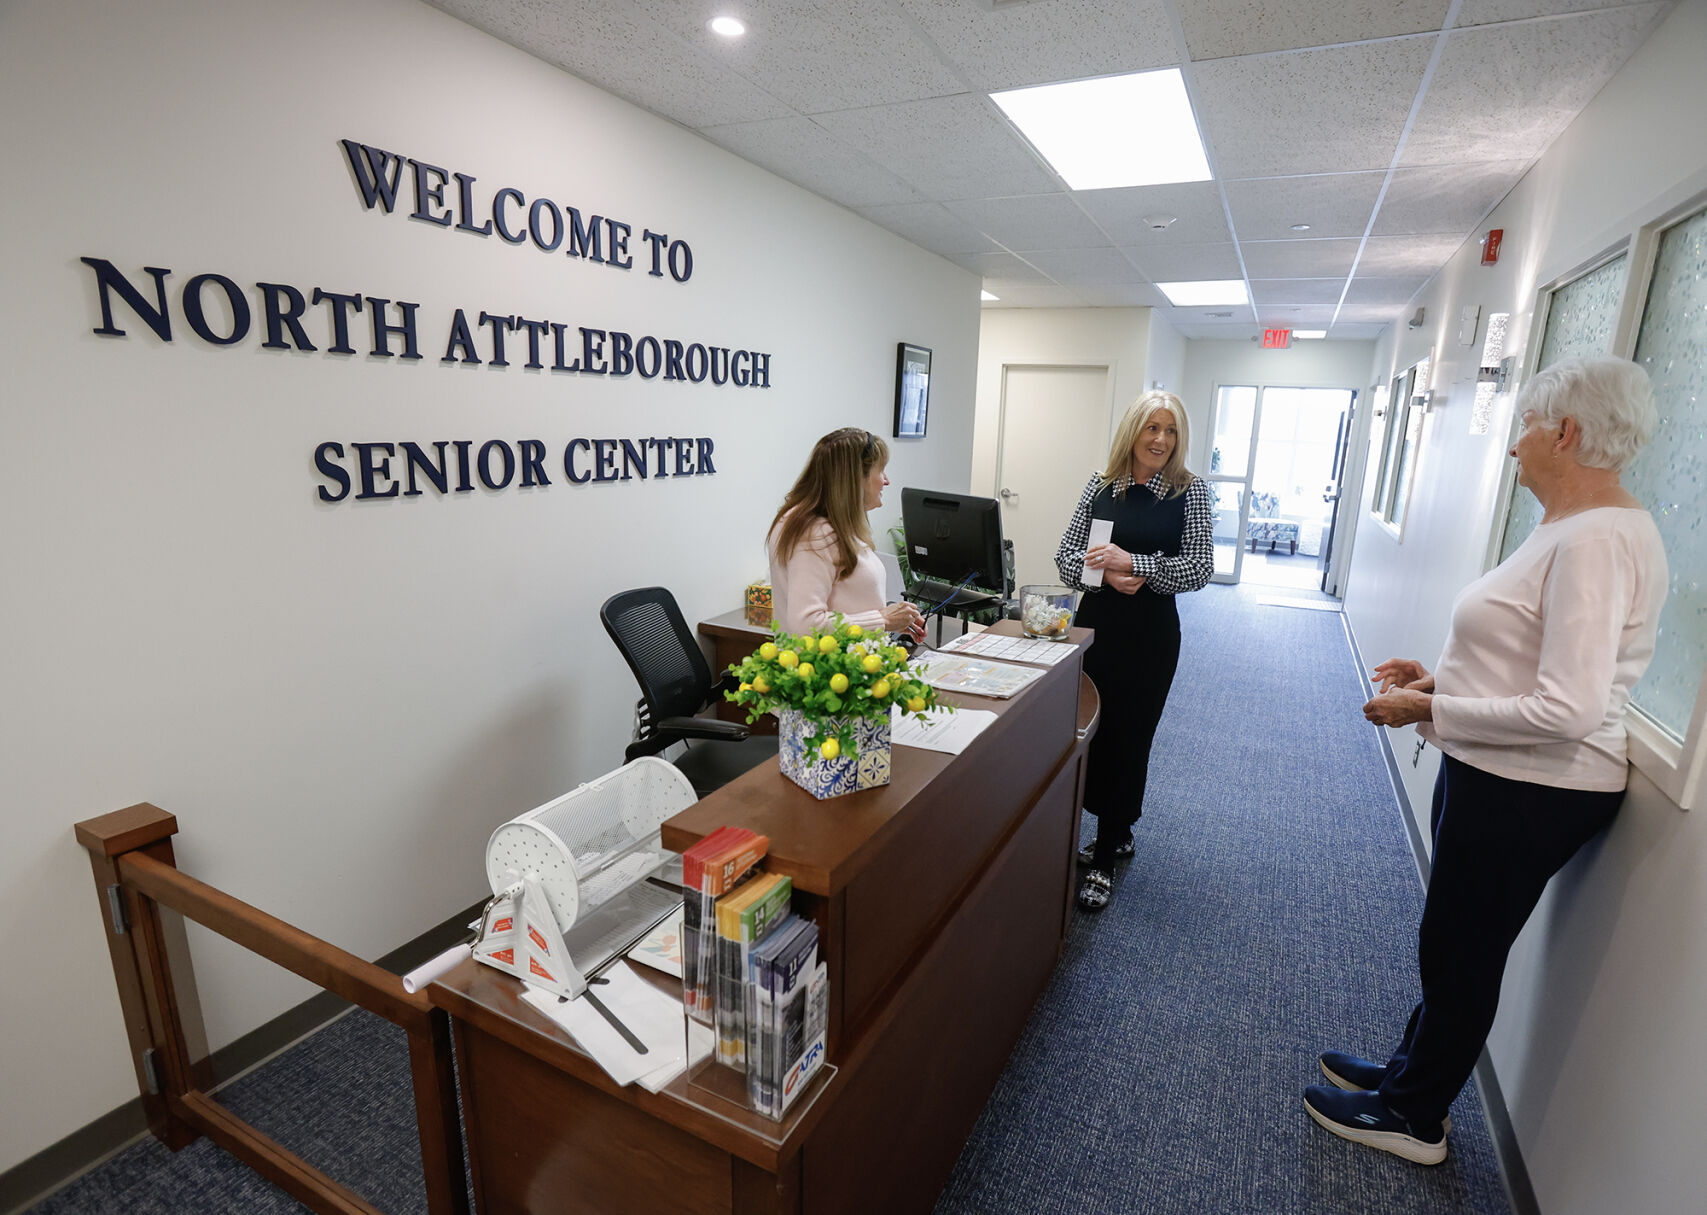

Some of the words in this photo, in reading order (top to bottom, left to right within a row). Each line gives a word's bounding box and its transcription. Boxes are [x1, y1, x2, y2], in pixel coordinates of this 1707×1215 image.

[340, 138, 633, 270] WELCOME
[642, 229, 693, 283] TO
[80, 256, 424, 360] NORTH
[441, 308, 772, 388] ATTLEBOROUGH
[1263, 329, 1290, 348] EXIT
[314, 439, 553, 502] SENIOR
[563, 437, 717, 484] CENTER
[723, 861, 735, 879] 16
[754, 906, 765, 925] 14
